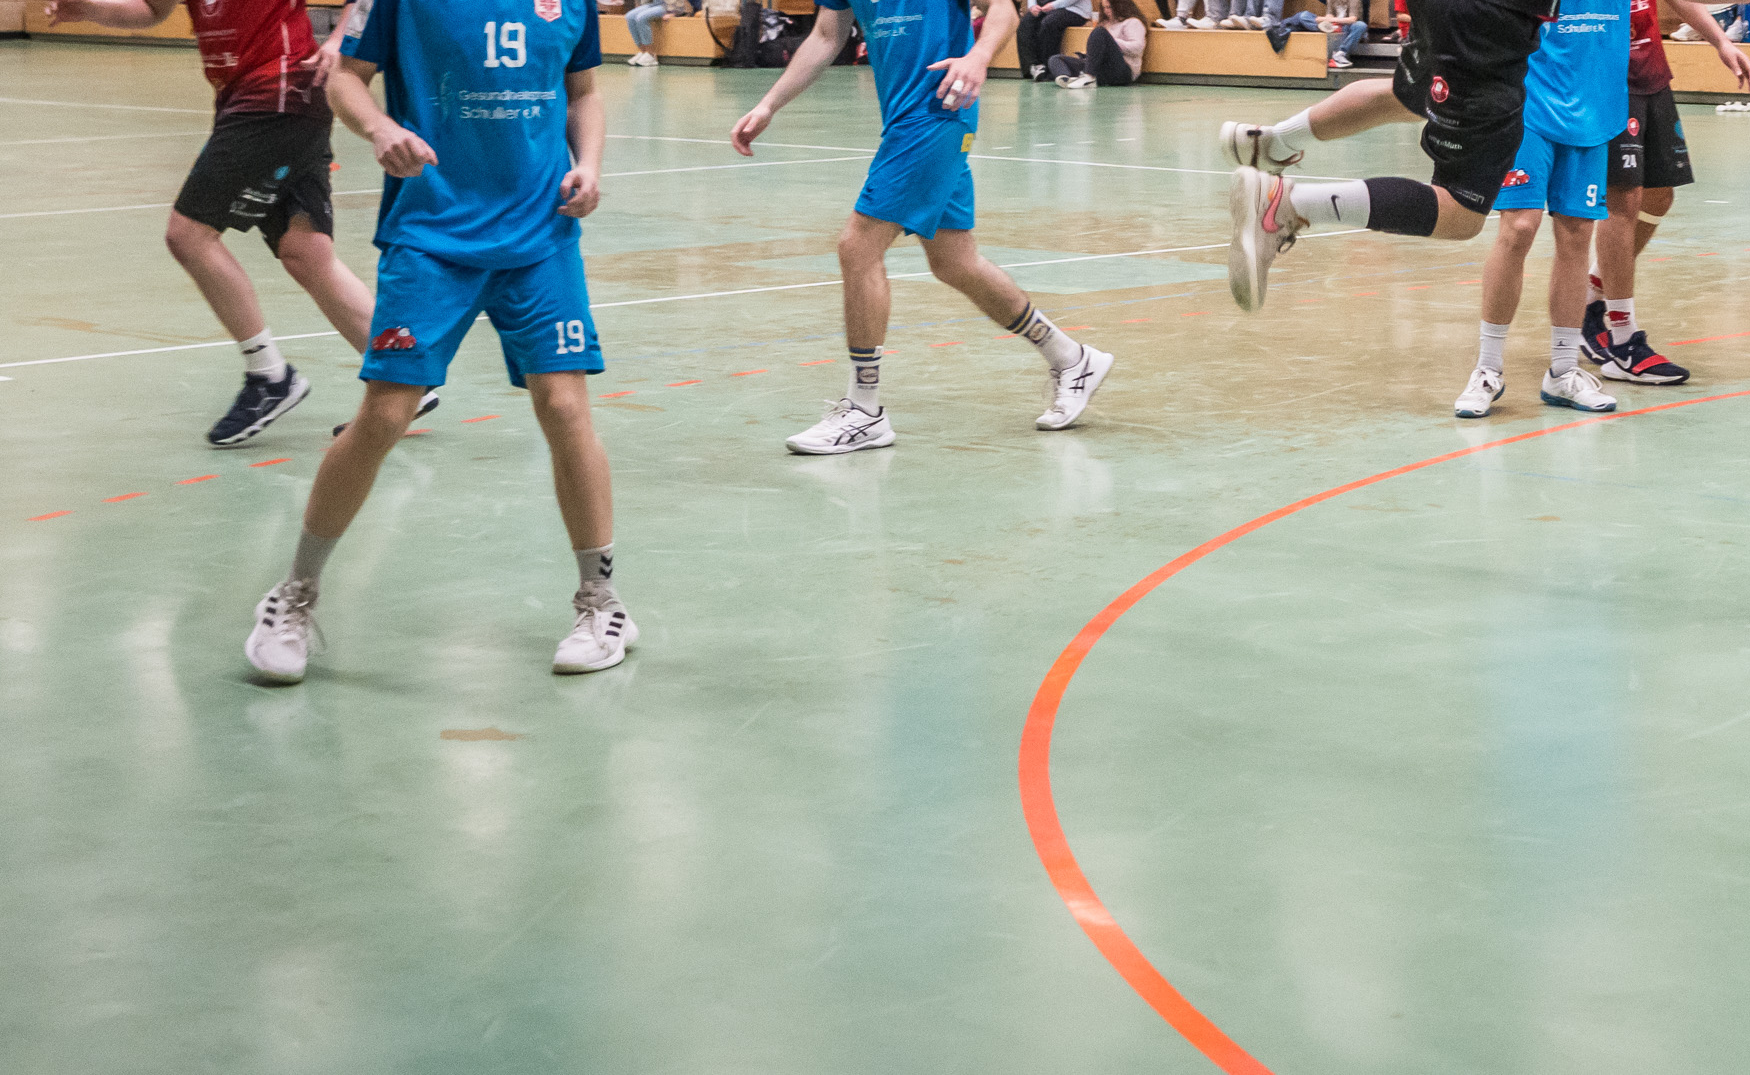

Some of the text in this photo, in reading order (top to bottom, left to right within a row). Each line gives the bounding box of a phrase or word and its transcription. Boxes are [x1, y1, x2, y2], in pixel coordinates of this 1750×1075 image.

[483, 21, 528, 68] 19
[1621, 154, 1637, 169] 24
[1585, 184, 1598, 207] 9
[554, 319, 585, 354] 19
